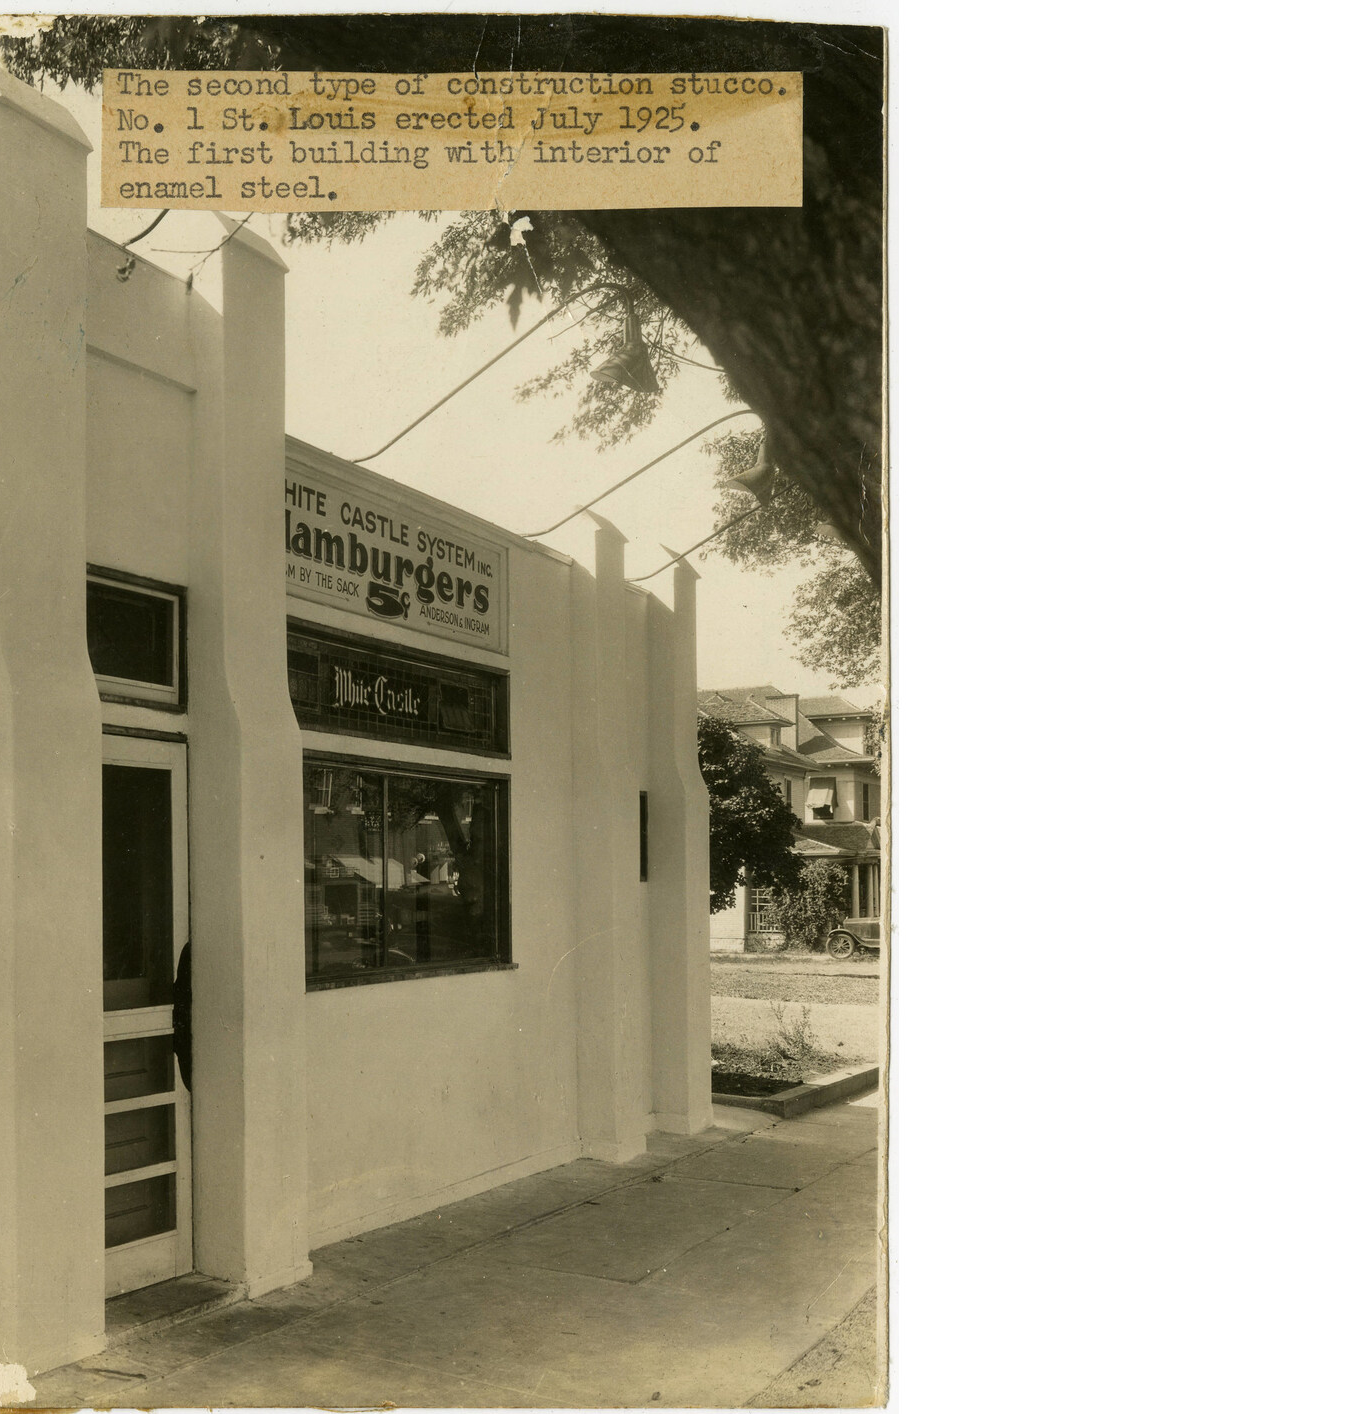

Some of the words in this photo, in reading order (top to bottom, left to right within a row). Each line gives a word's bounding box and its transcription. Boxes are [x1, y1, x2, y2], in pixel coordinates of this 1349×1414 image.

[285, 478, 327, 517] HITE
[340, 502, 410, 547] CASTLE
[417, 530, 475, 571] SYSTEM
[477, 559, 494, 579] INC.
[285, 564, 296, 579] M
[300, 566, 311, 583] BY
[315, 571, 333, 590] THE
[336, 577, 360, 598] SACK
[419, 605, 459, 628] ANDERSON
[464, 616, 490, 636] INGRAM
